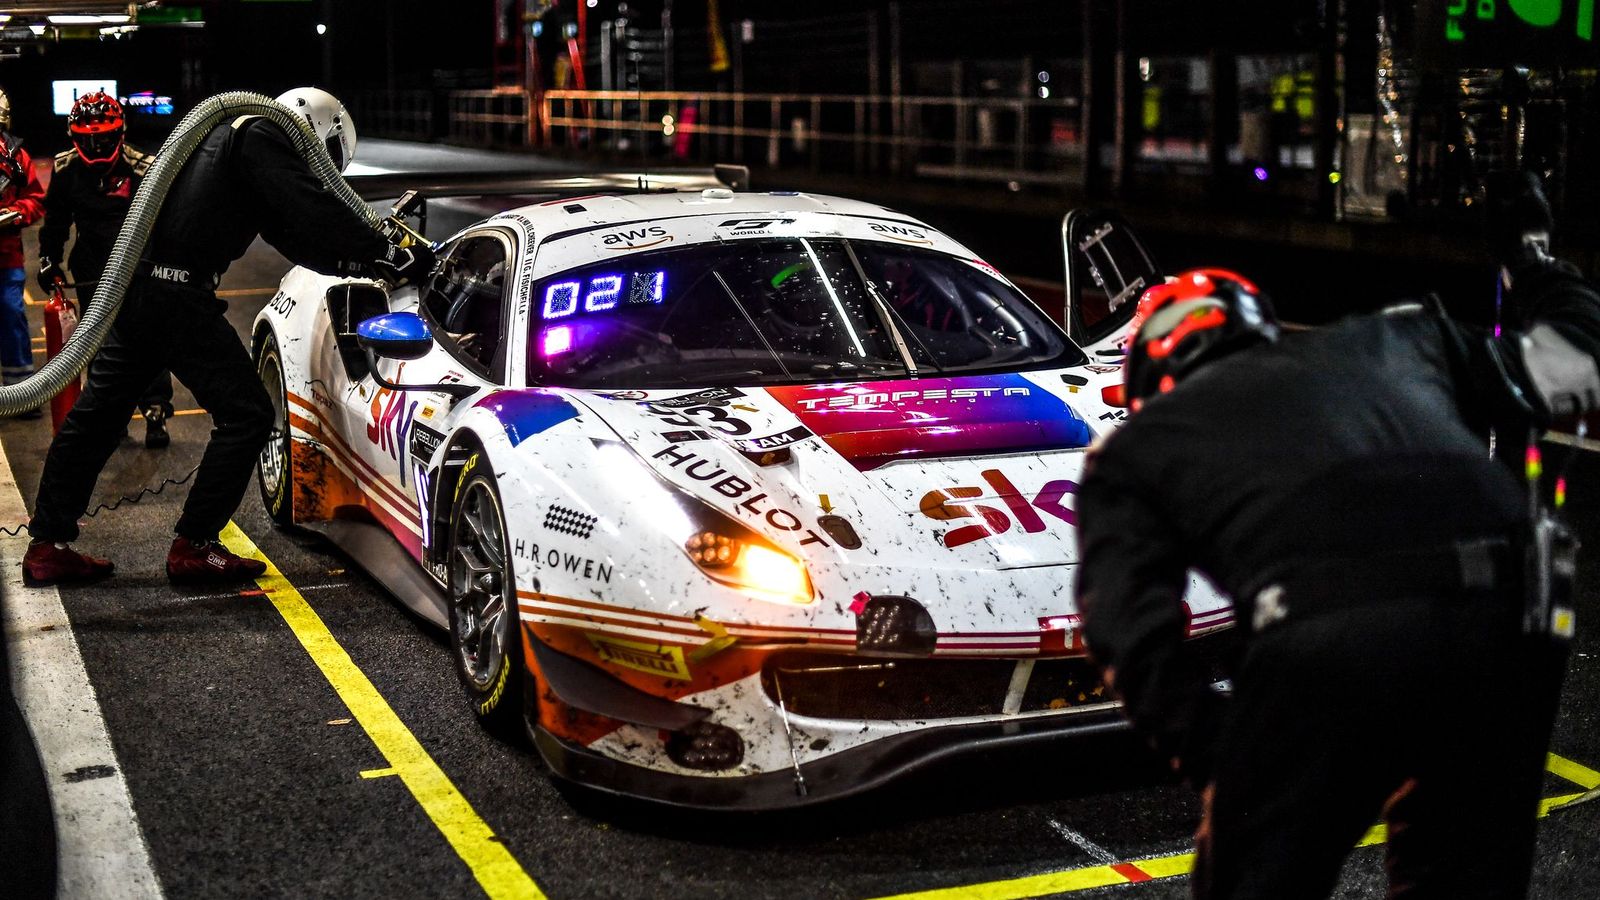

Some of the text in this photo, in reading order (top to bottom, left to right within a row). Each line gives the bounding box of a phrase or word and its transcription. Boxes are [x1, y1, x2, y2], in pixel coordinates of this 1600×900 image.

[601, 225, 667, 246] aws
[867, 221, 926, 239] aws
[151, 265, 190, 283] MRTC
[543, 271, 664, 319] 021
[797, 387, 1031, 410] TEMPESTA
[652, 445, 830, 548] HUBLOT
[919, 469, 1082, 549] sk
[480, 653, 511, 715] PIRELLI
